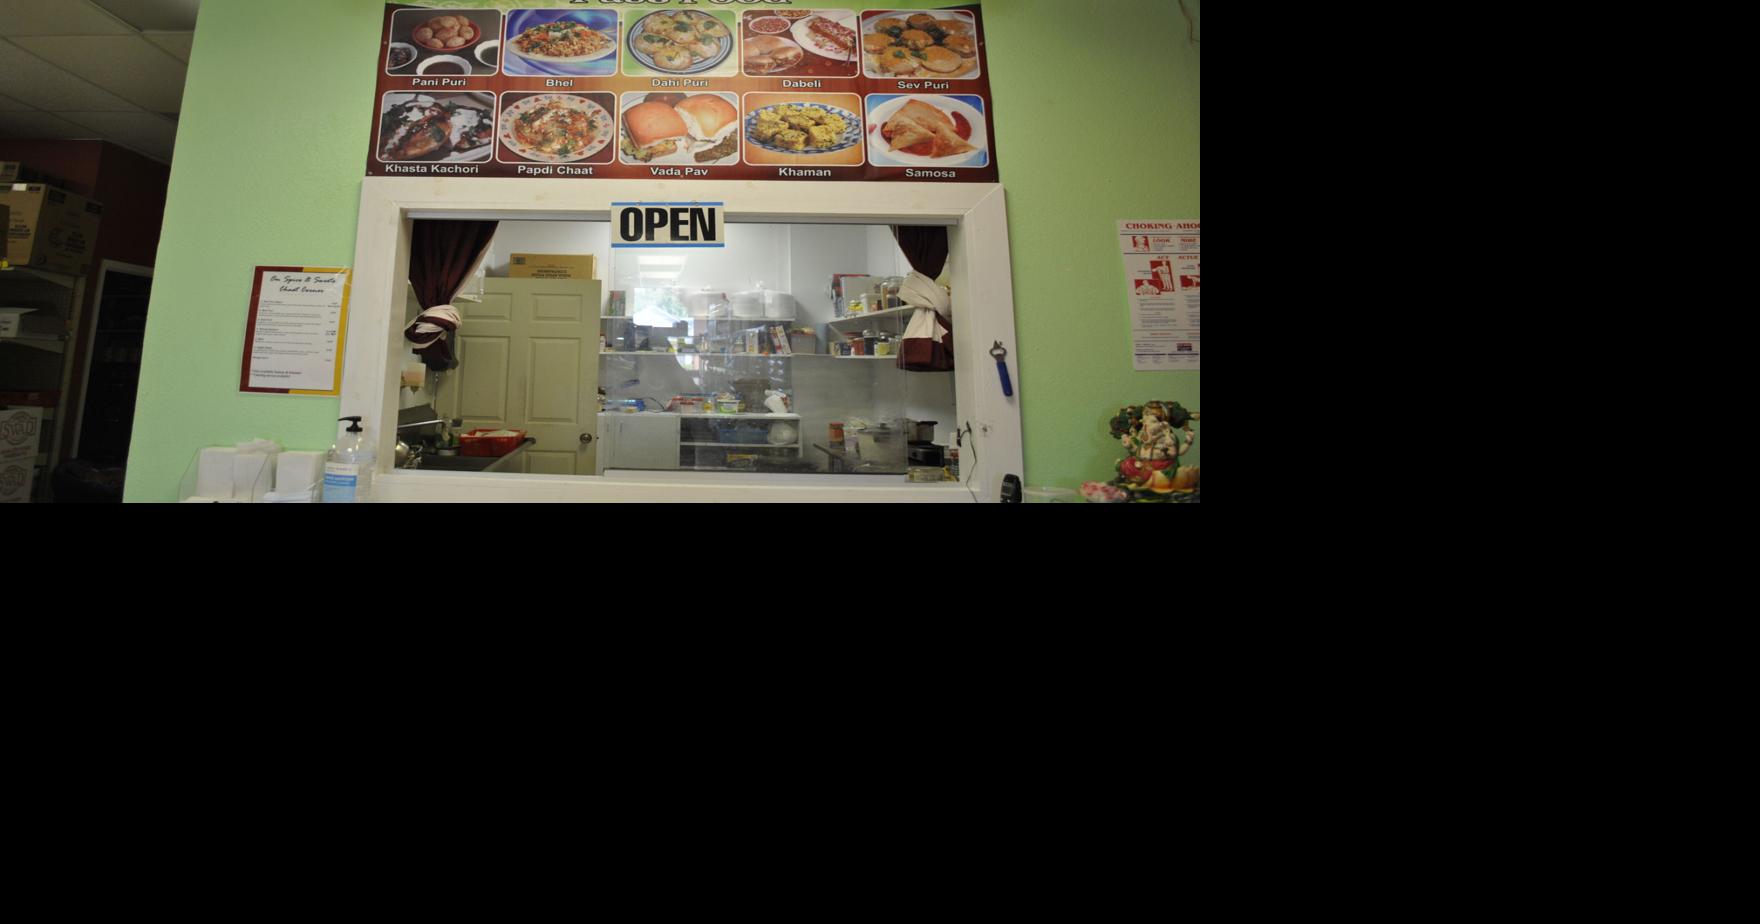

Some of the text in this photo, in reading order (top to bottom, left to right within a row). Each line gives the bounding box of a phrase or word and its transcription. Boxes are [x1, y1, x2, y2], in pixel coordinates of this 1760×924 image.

[412, 77, 466, 87] Pani Puri
[545, 78, 574, 88] Bhel
[651, 78, 708, 88] Dahi Puri
[782, 78, 822, 89] Dabeli
[897, 80, 949, 90] Sev Puri
[385, 163, 479, 175] Khasta Kachori
[517, 164, 593, 176] Papdi Chaat
[650, 166, 708, 177] Vada Pav
[778, 167, 832, 177] Khaman
[905, 168, 956, 179] Samosa
[619, 207, 716, 242] OPEN
[1125, 222, 1173, 230] CHOKING
